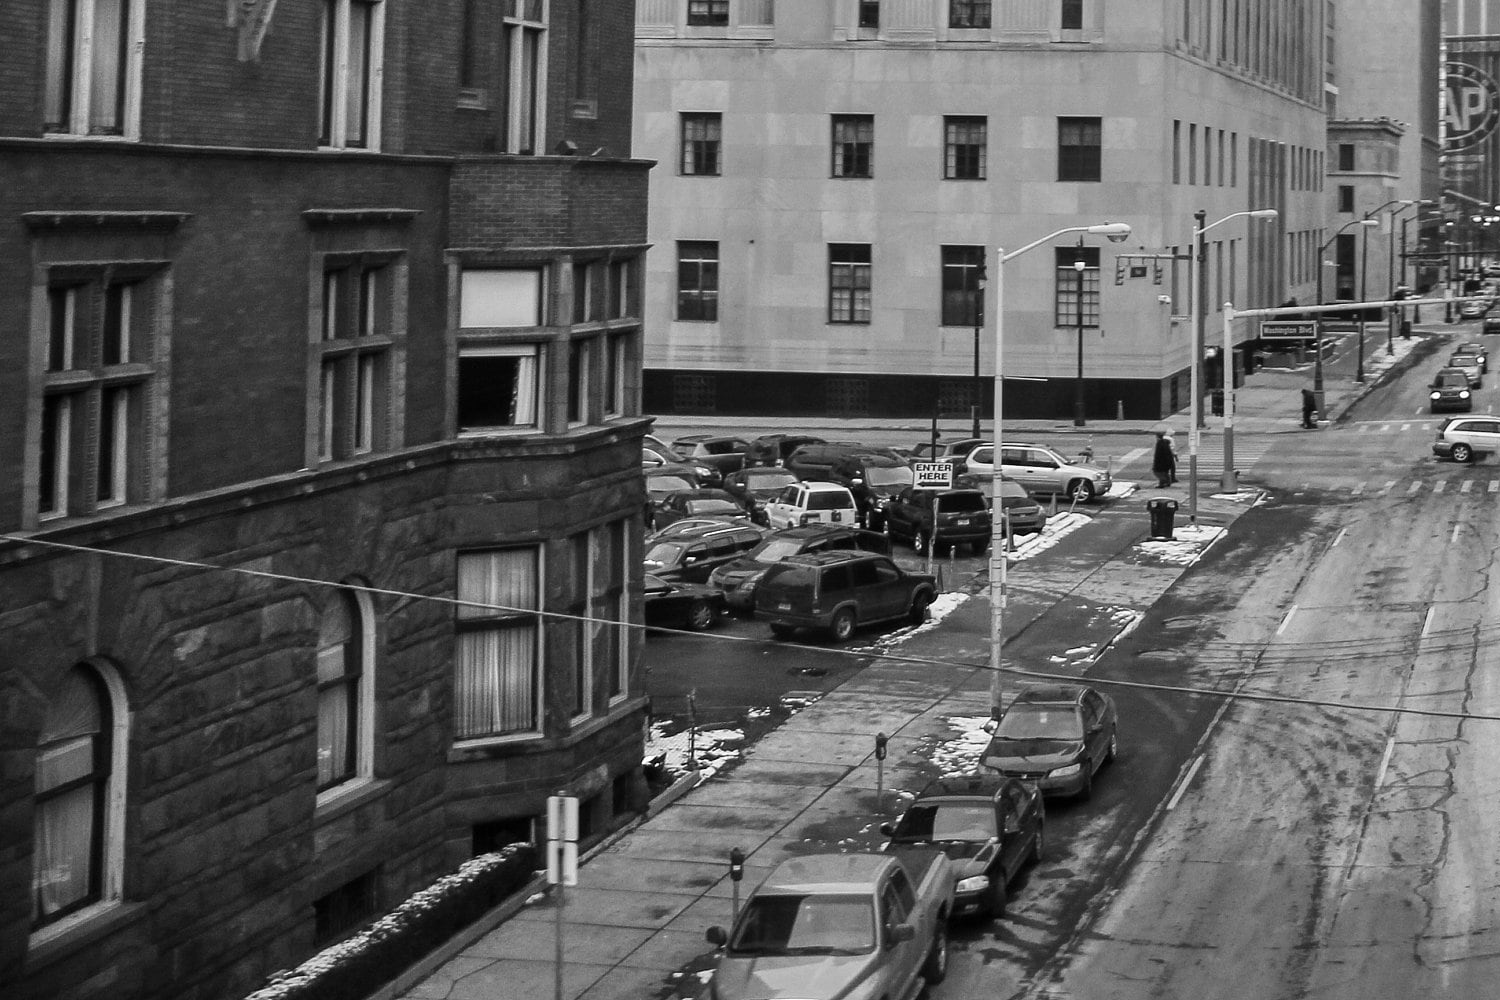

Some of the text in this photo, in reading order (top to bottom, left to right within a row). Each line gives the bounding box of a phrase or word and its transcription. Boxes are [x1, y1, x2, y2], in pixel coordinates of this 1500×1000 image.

[1263, 325, 1313, 335] Washington Blvd
[919, 472, 948, 480] HERE
